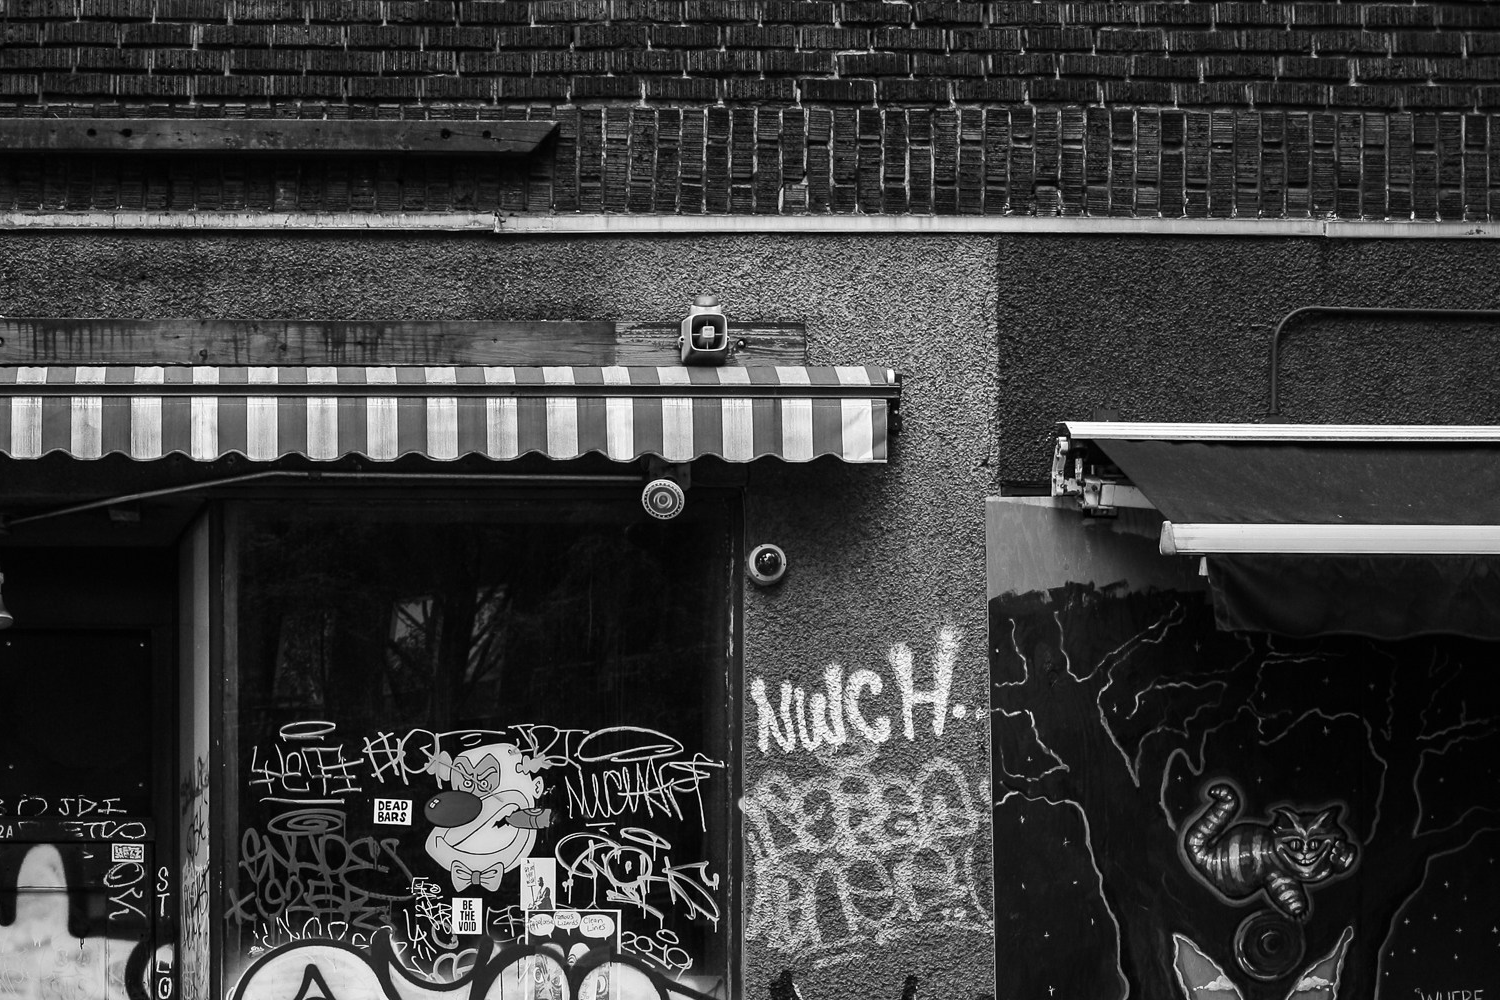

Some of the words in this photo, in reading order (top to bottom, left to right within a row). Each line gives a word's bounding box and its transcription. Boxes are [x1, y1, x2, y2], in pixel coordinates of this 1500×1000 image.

[378, 801, 408, 811] DEAD
[378, 812, 407, 822] BARS
[462, 900, 473, 911] BE
[460, 911, 475, 921] THE
[458, 921, 477, 932] VOID
